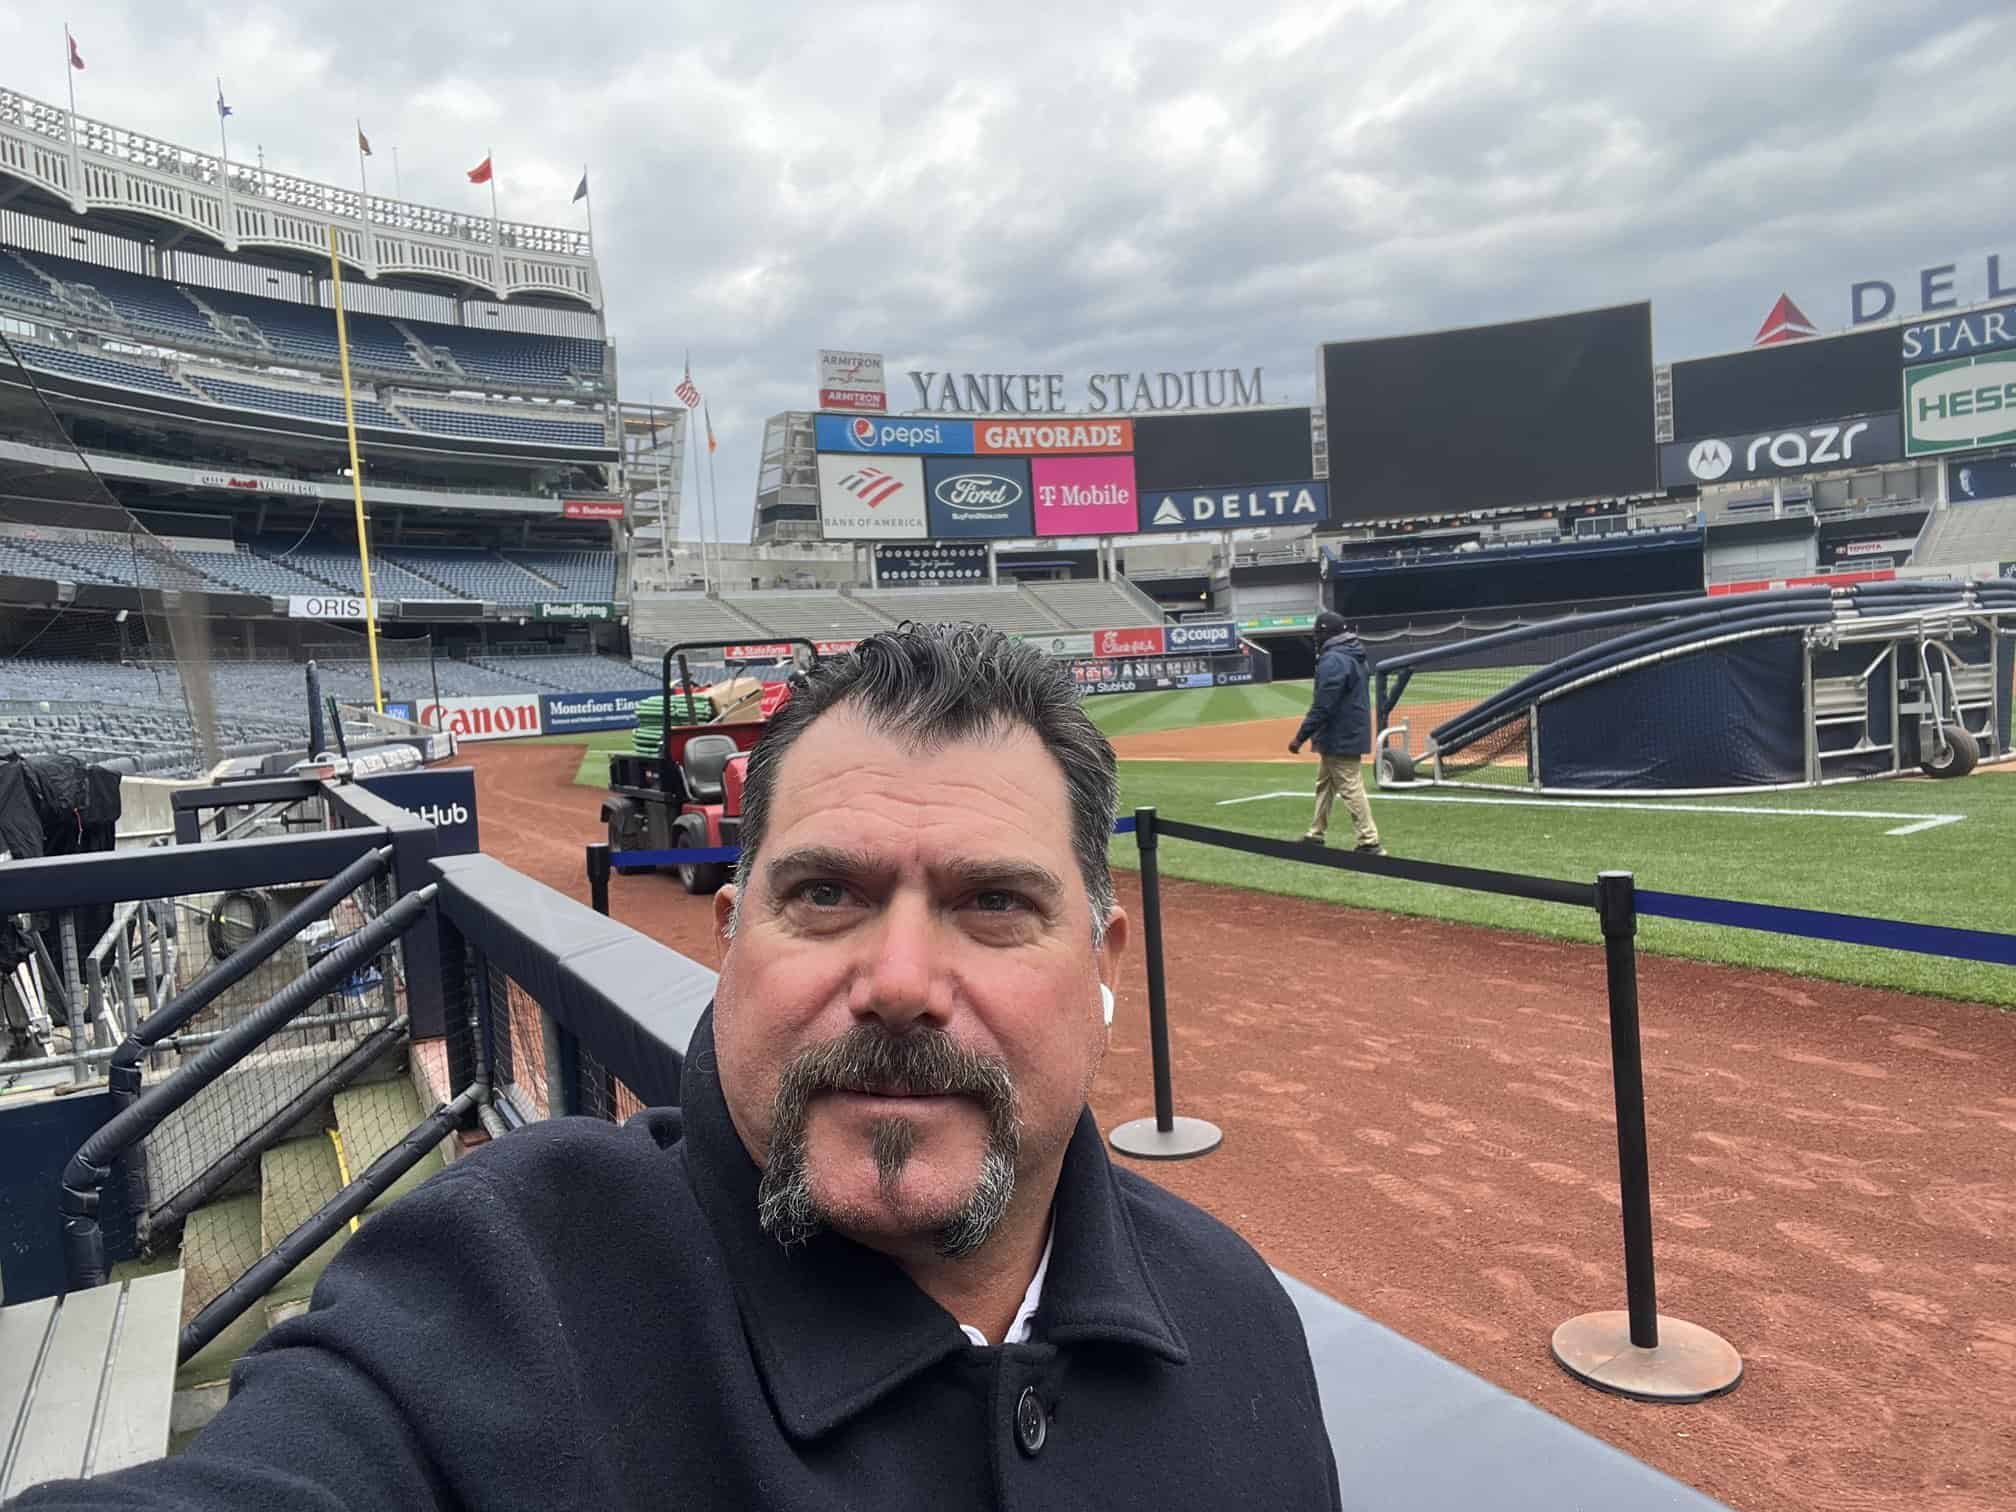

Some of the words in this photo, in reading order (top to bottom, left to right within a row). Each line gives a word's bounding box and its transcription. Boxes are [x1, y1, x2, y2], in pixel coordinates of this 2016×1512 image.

[1852, 254, 2016, 326] DEL
[1902, 312, 2016, 358] STAR
[823, 355, 881, 368] ARMITRON
[828, 391, 880, 402] ARMITRON
[906, 370, 1064, 413] YANKEE
[1087, 367, 1265, 413] STADIUM
[880, 425, 943, 447] pepsi
[984, 424, 1122, 449] GATORADE
[1747, 422, 1868, 472] razr
[950, 478, 1007, 504] Ford
[1061, 485, 1129, 506] Mobile
[1193, 489, 1317, 521] DELTA
[824, 518, 853, 527] BANK
[857, 518, 872, 527] OF
[874, 518, 924, 527] AMERICA
[1849, 544, 1882, 552] TOYOTA
[306, 598, 361, 616] ORIS
[543, 603, 575, 617] Poland
[575, 603, 608, 618] Spring
[1188, 628, 1229, 642] coupa
[550, 699, 613, 715] Montefiore
[615, 698, 640, 711] Eins
[420, 701, 538, 735] Canon
